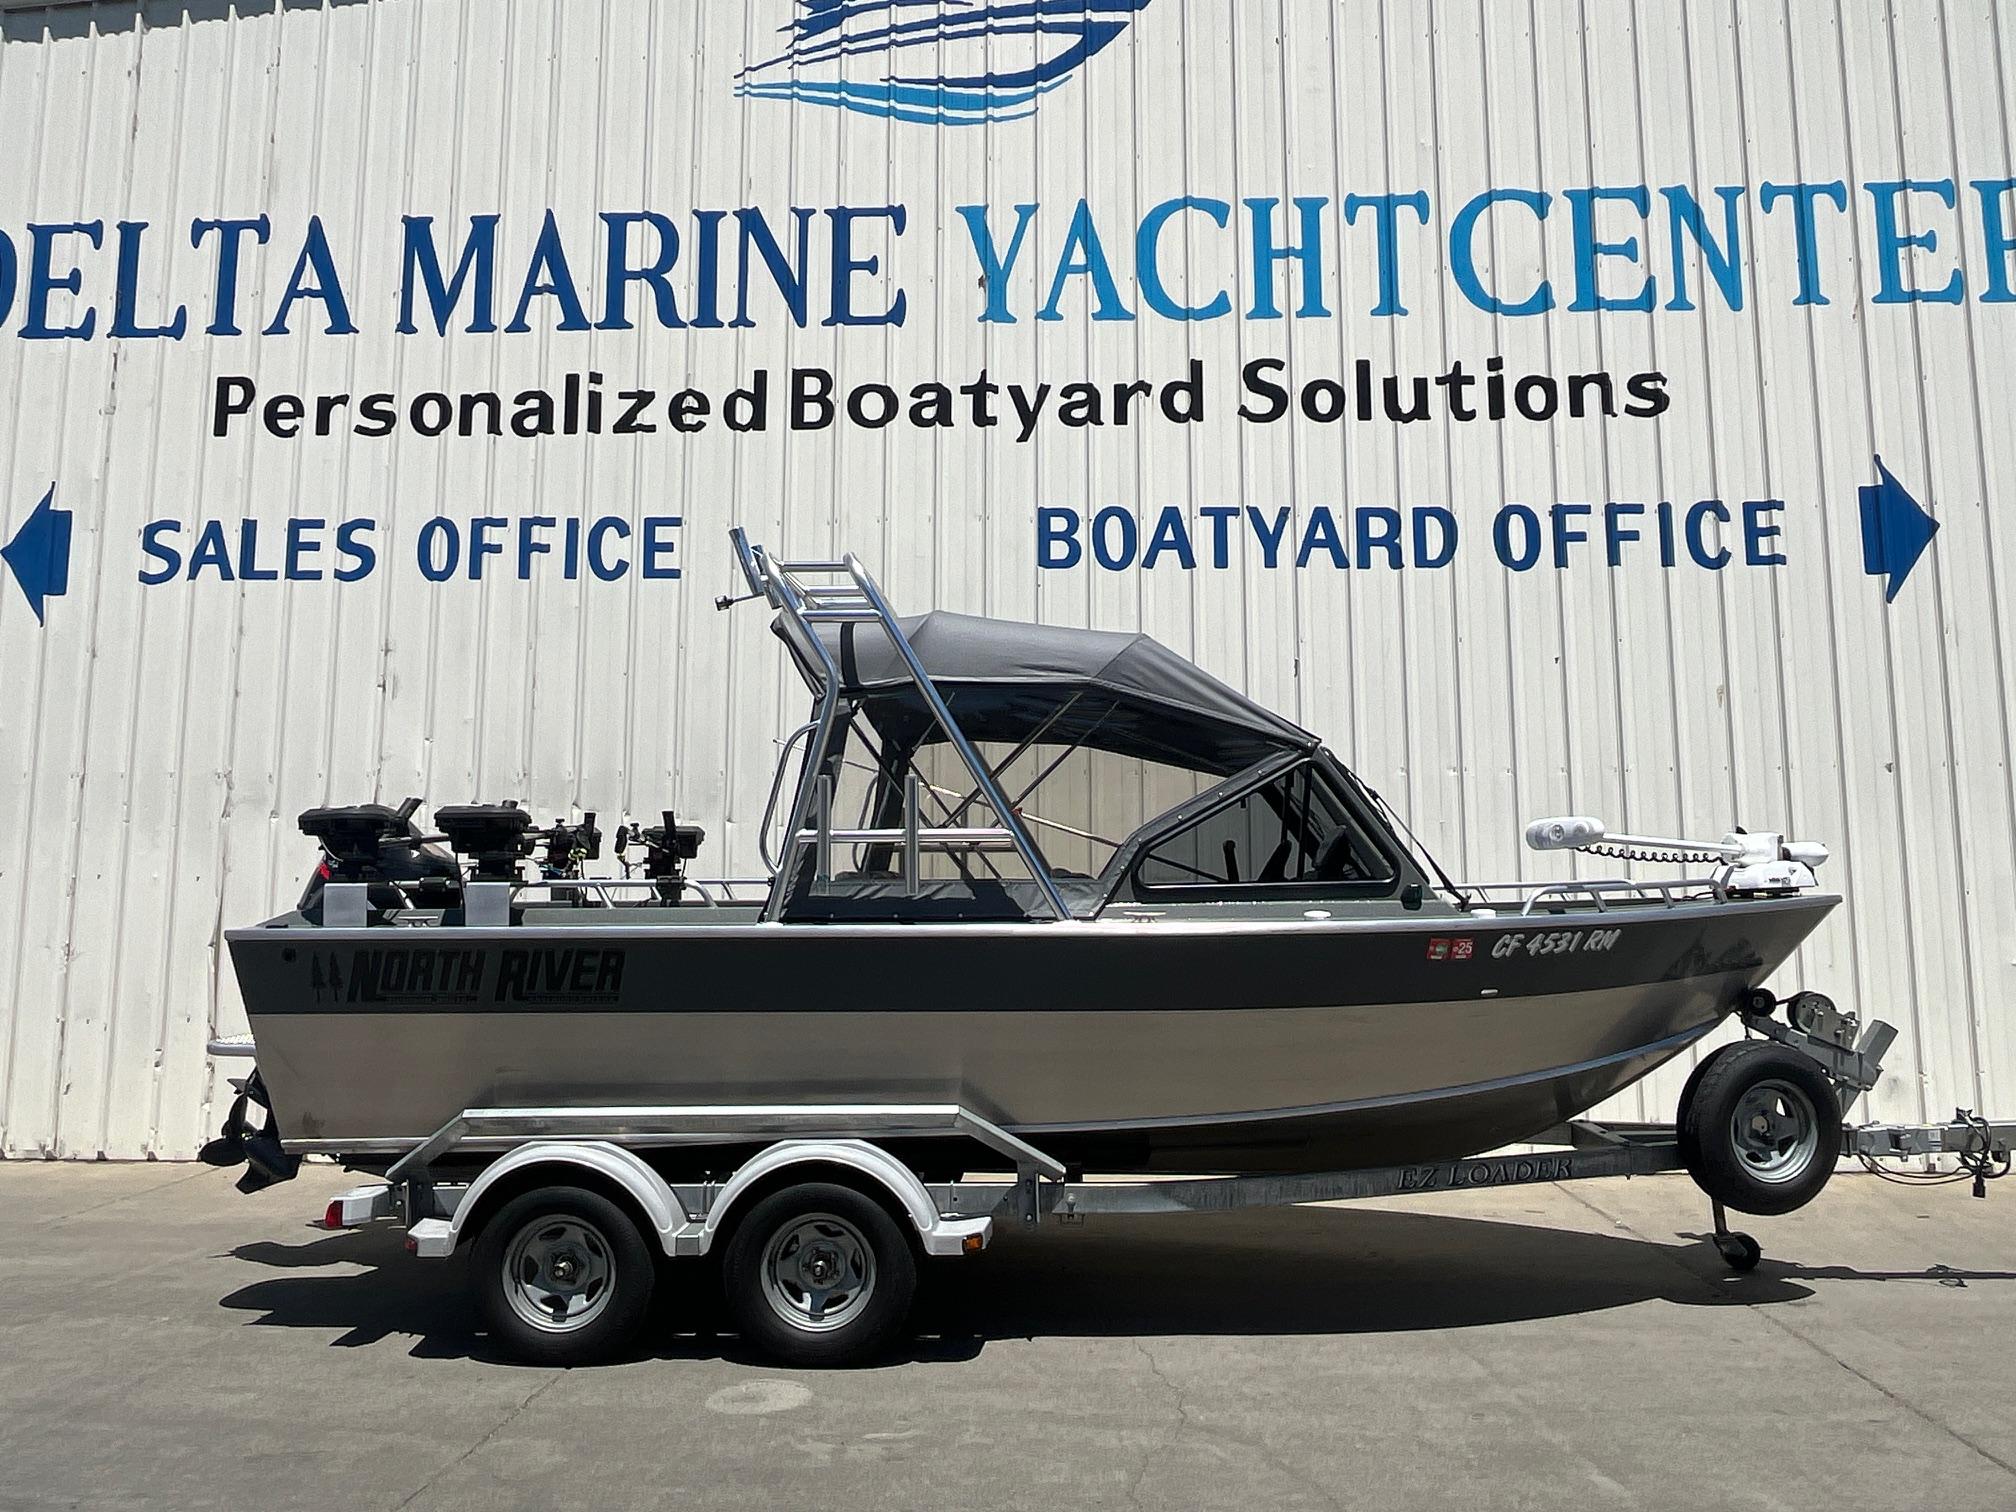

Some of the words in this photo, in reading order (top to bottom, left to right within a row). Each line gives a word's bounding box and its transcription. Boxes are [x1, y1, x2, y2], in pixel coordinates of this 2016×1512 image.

[0, 213, 359, 340] ELTA
[395, 204, 907, 337] MARINE
[212, 369, 768, 438] Personalized
[790, 359, 1203, 443] Boatyard
[1237, 356, 1671, 424] Solutions
[138, 518, 376, 585] SALES
[417, 515, 682, 582] OFFICE
[1036, 506, 1458, 571] BOATYARD
[1493, 499, 1787, 572] OFFICE
[346, 948, 486, 1002] NORTH
[495, 948, 627, 1002] RIVER
[1491, 933, 1526, 959] CF
[1526, 930, 1584, 957] 4531
[1398, 1166, 1438, 1190] EZ
[1449, 1157, 1573, 1186] LOADER
